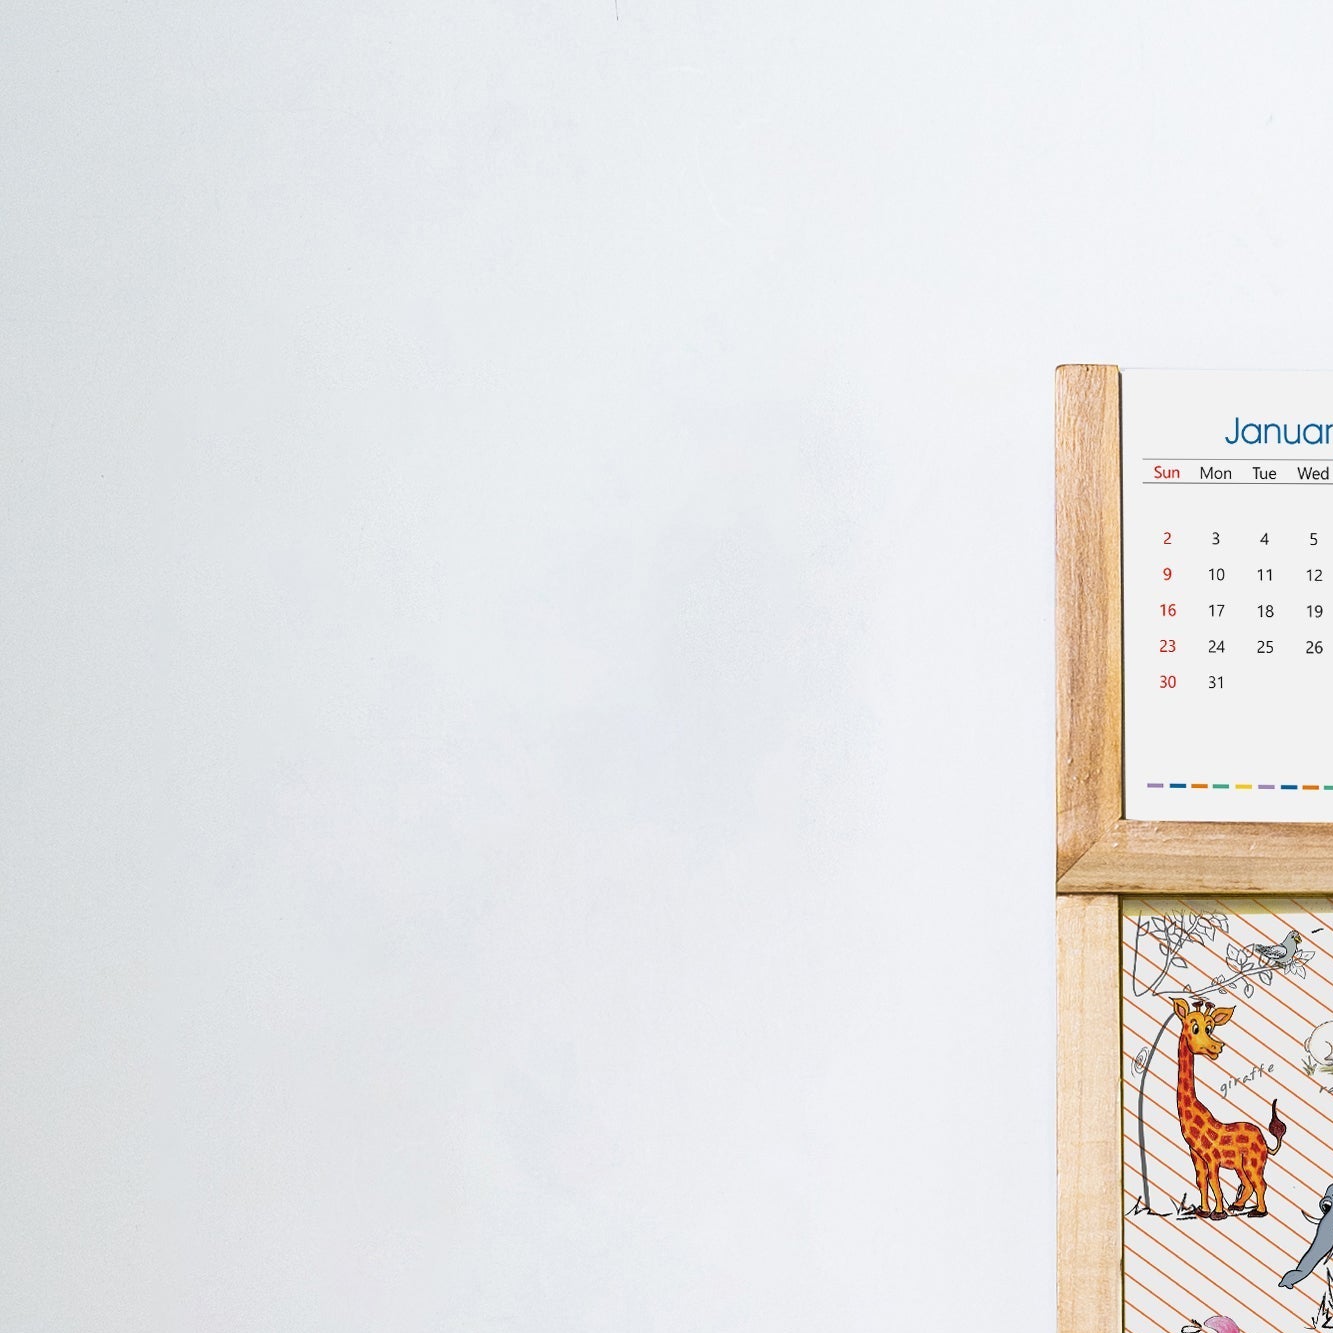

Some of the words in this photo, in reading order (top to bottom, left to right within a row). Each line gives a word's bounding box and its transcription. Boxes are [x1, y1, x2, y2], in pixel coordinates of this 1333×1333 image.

[1154, 466, 1180, 479] Sun
[1201, 467, 1231, 479] Mon
[1252, 467, 1276, 479] Tue
[1297, 467, 1329, 480] Wed
[1163, 532, 1172, 544] 2
[1211, 532, 1220, 545] 3
[1259, 533, 1270, 545] 4
[1309, 533, 1318, 545] 5
[1162, 568, 1173, 581] 9
[1208, 568, 1226, 581] 10
[1257, 569, 1272, 581] 11
[1306, 569, 1324, 581] 12
[1159, 604, 1177, 617] 16
[1208, 605, 1226, 617] 17
[1257, 605, 1275, 617] 18
[1306, 605, 1324, 618] 19
[1159, 640, 1177, 652] 23
[1208, 640, 1226, 653] 24
[1256, 641, 1274, 653] 25
[1305, 641, 1324, 654] 26
[1159, 675, 1177, 688] 30
[1208, 676, 1223, 688] 31
[1220, 1062, 1275, 1098] giraffe
